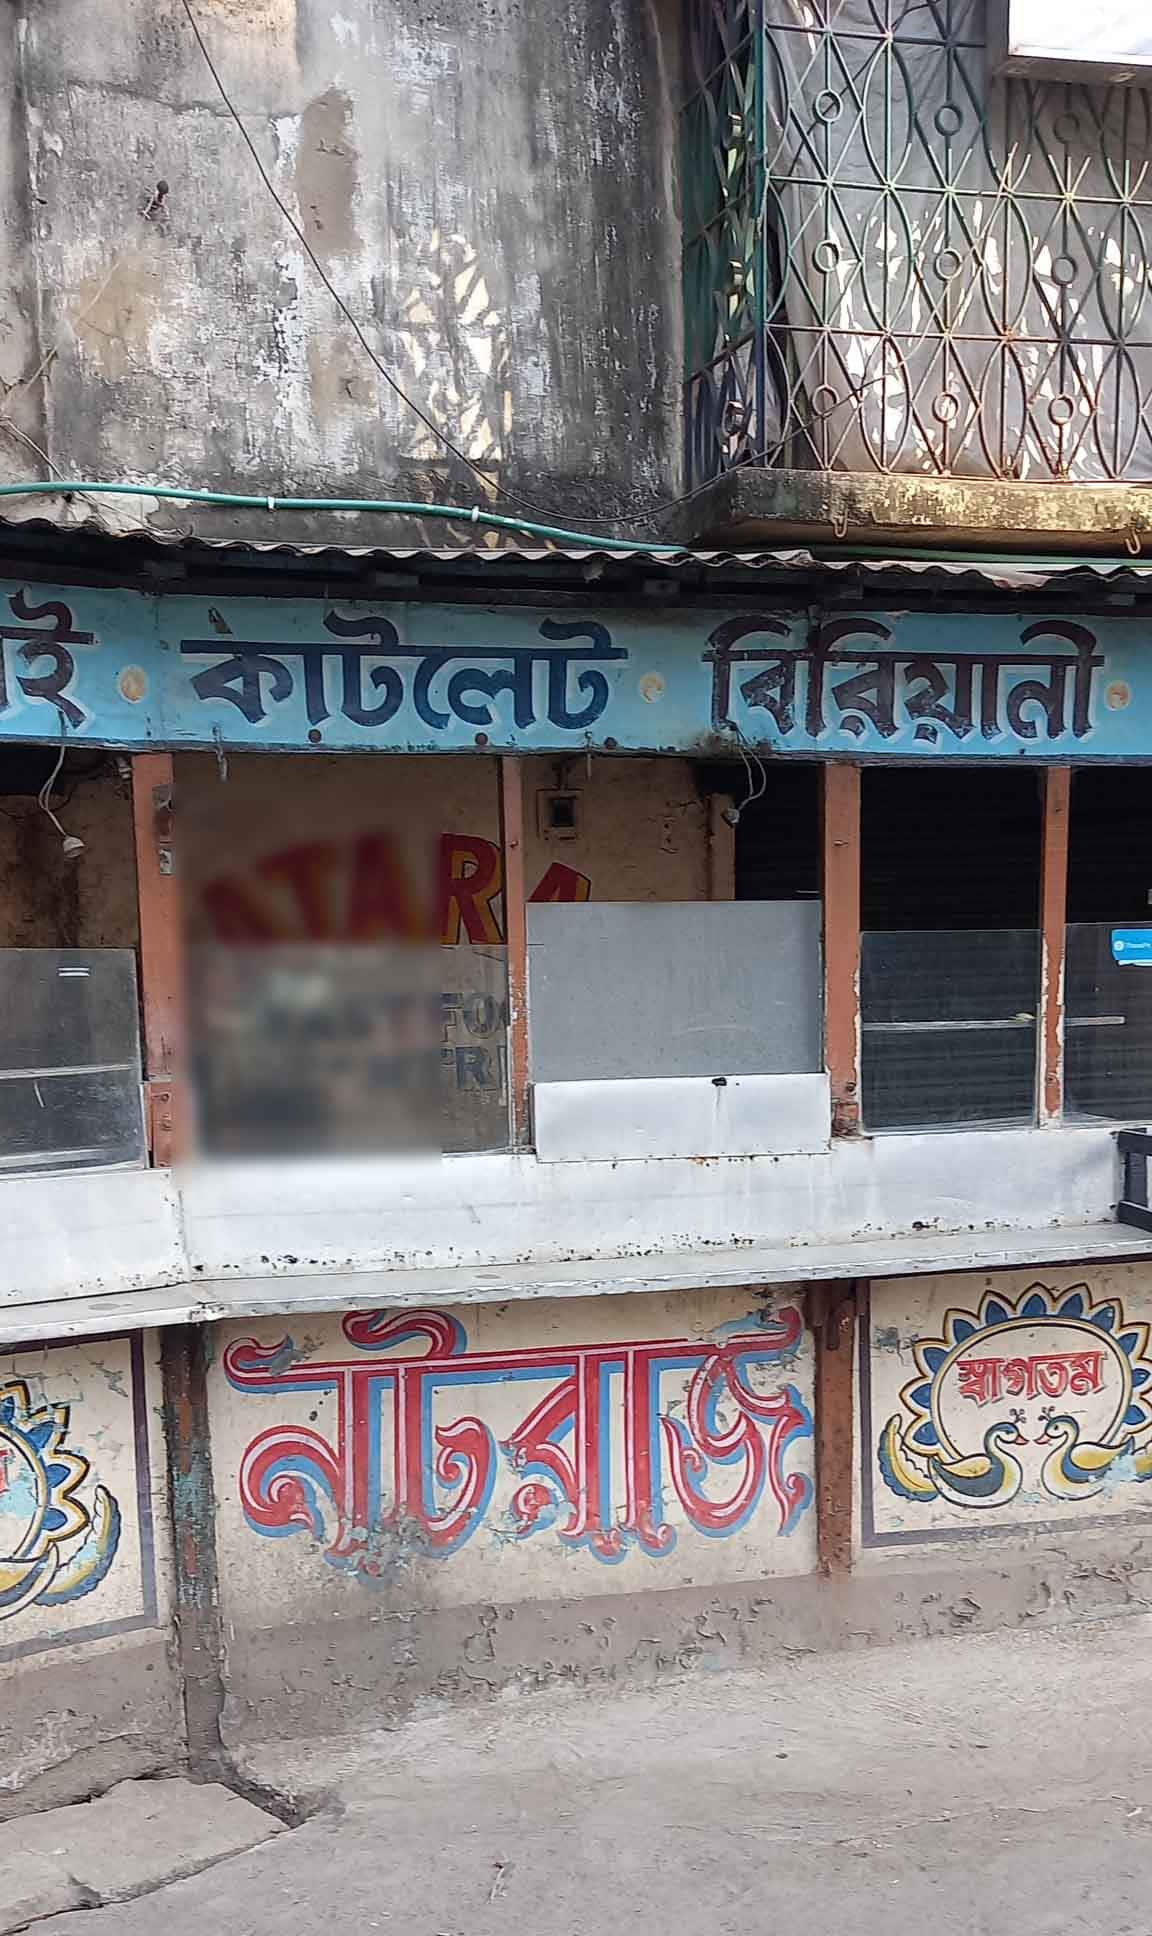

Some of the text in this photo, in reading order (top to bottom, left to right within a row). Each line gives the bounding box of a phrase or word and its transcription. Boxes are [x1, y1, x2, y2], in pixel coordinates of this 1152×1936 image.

[0, 586, 94, 729] ই
[180, 609, 629, 730] কাটলেট
[702, 614, 1105, 745] বিরিয়ানী
[956, 1350, 1106, 1408] স্বাগতম
[223, 1306, 815, 1586] নটরাজ
